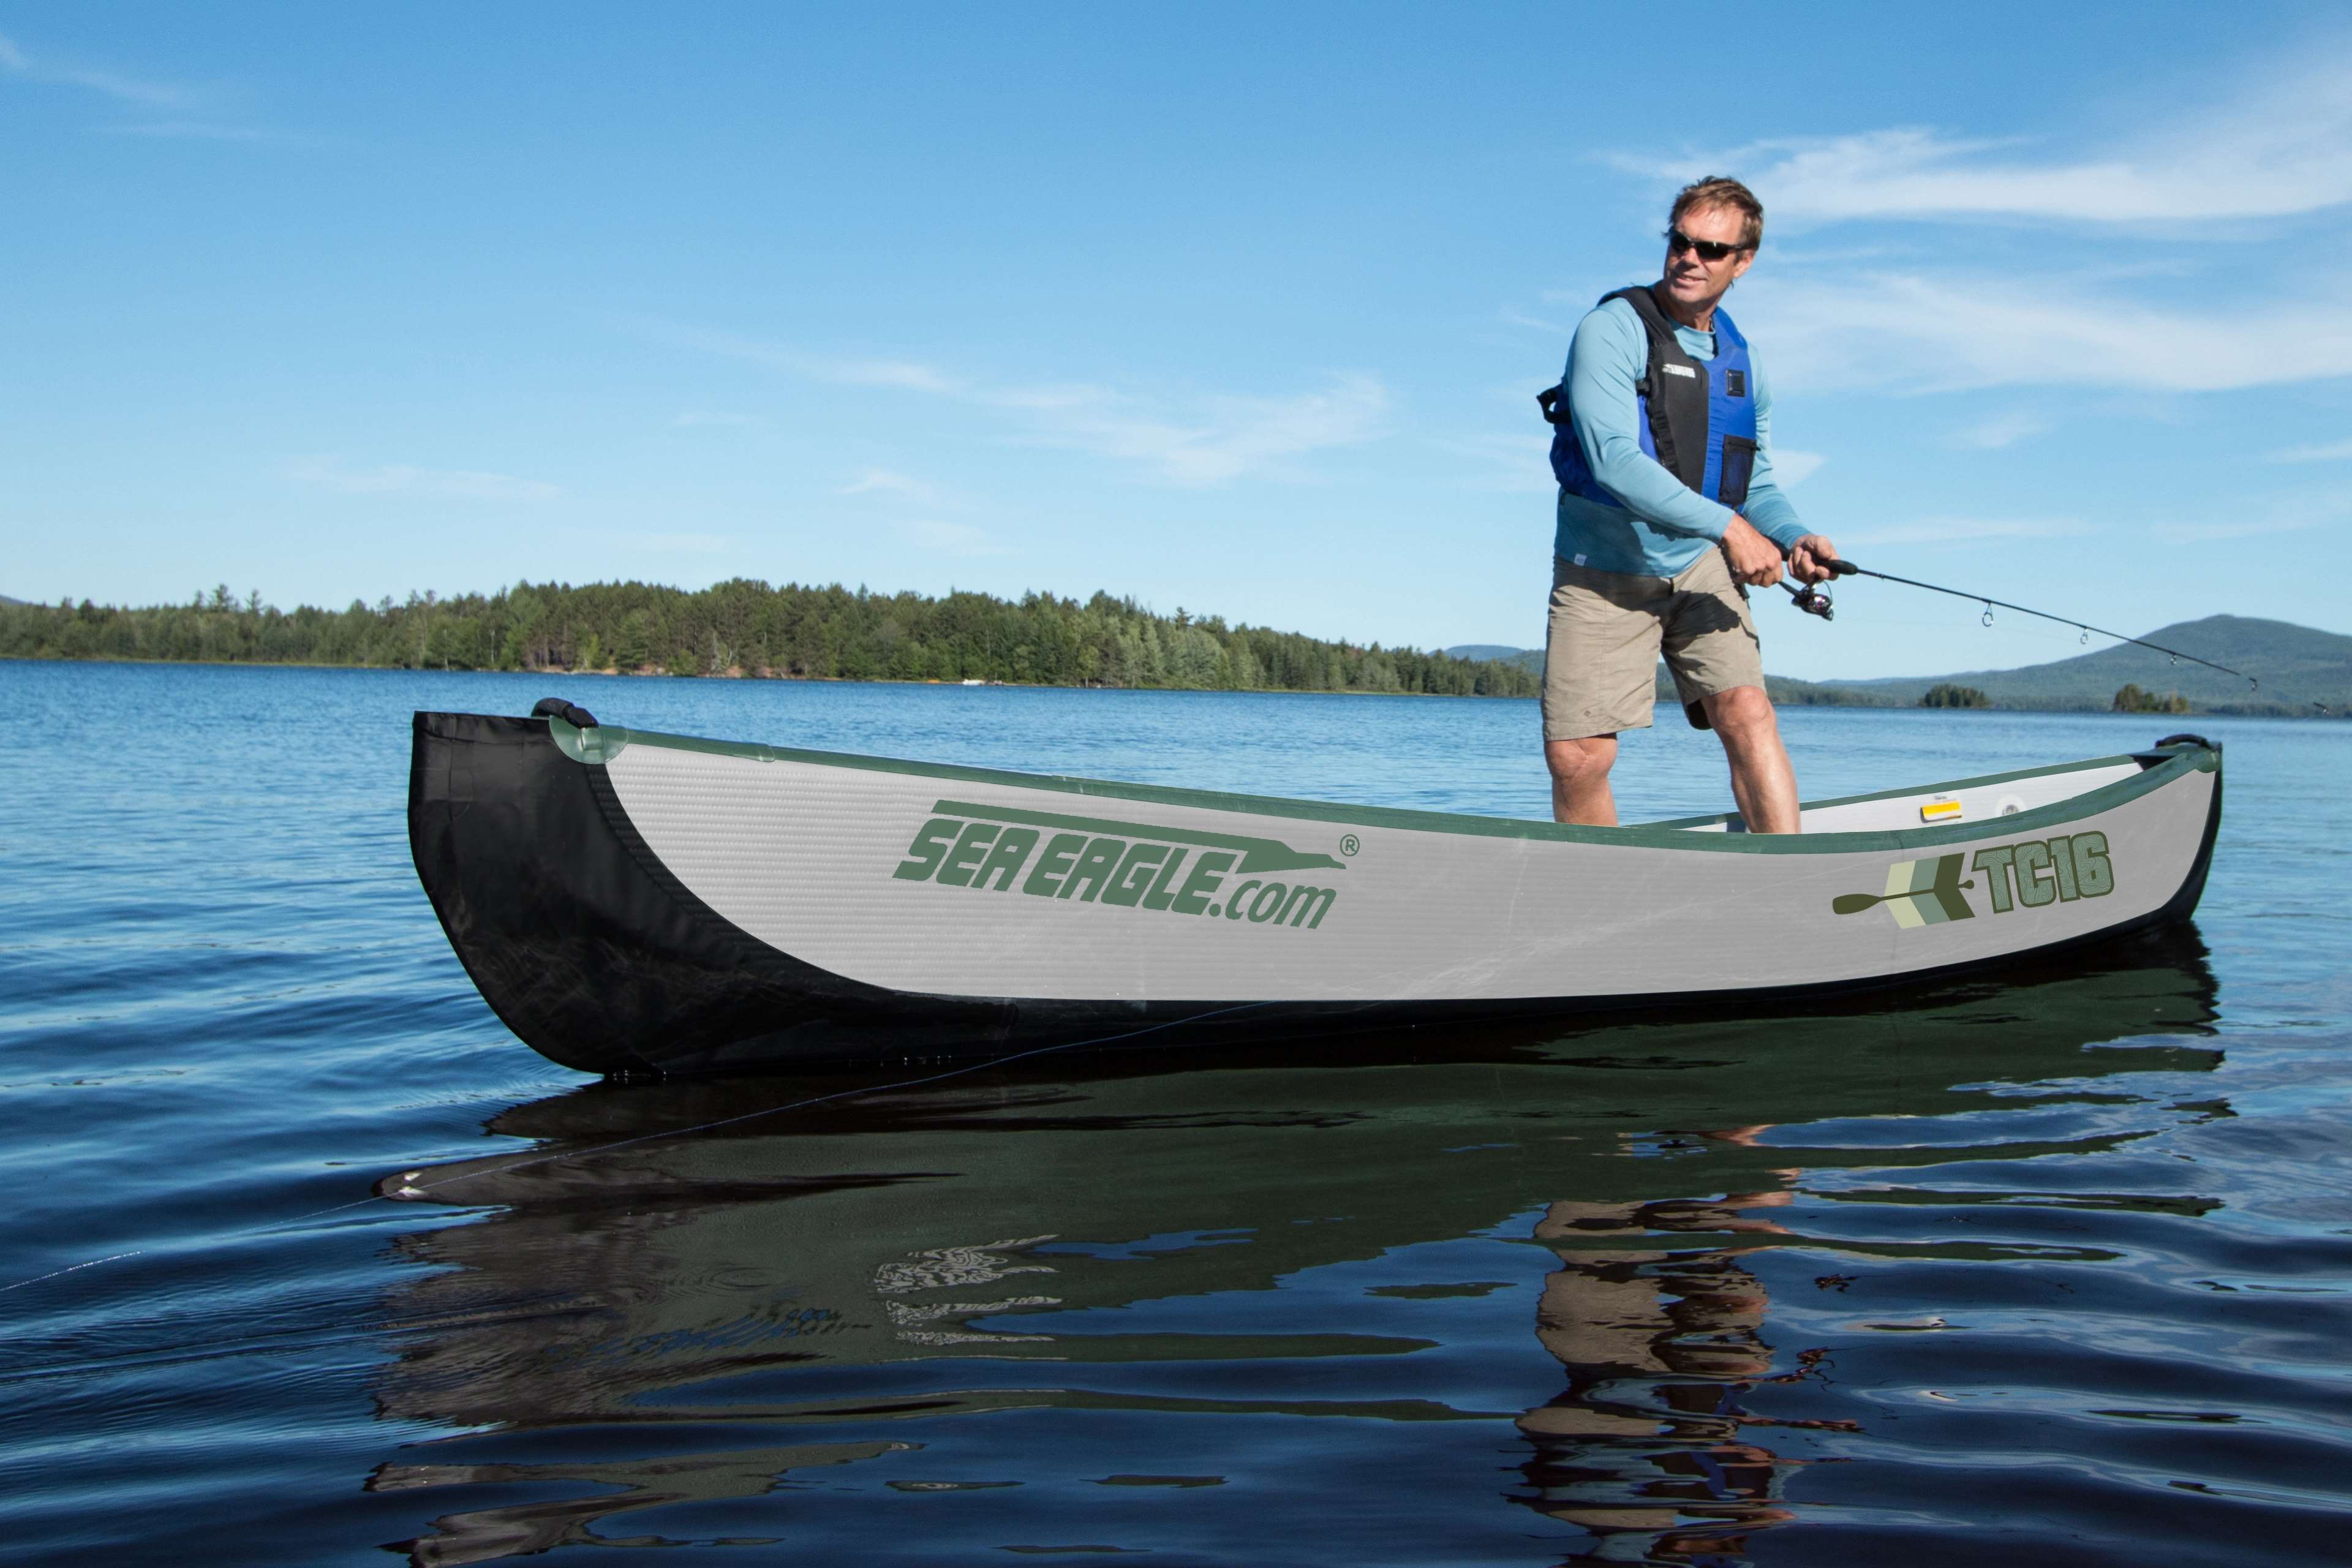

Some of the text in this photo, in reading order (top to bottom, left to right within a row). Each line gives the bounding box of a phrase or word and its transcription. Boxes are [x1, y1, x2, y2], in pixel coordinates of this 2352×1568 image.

[892, 819, 1039, 891] SEA
[1023, 834, 1336, 928] EAGLE.com
[1971, 831, 2115, 914] TC16
